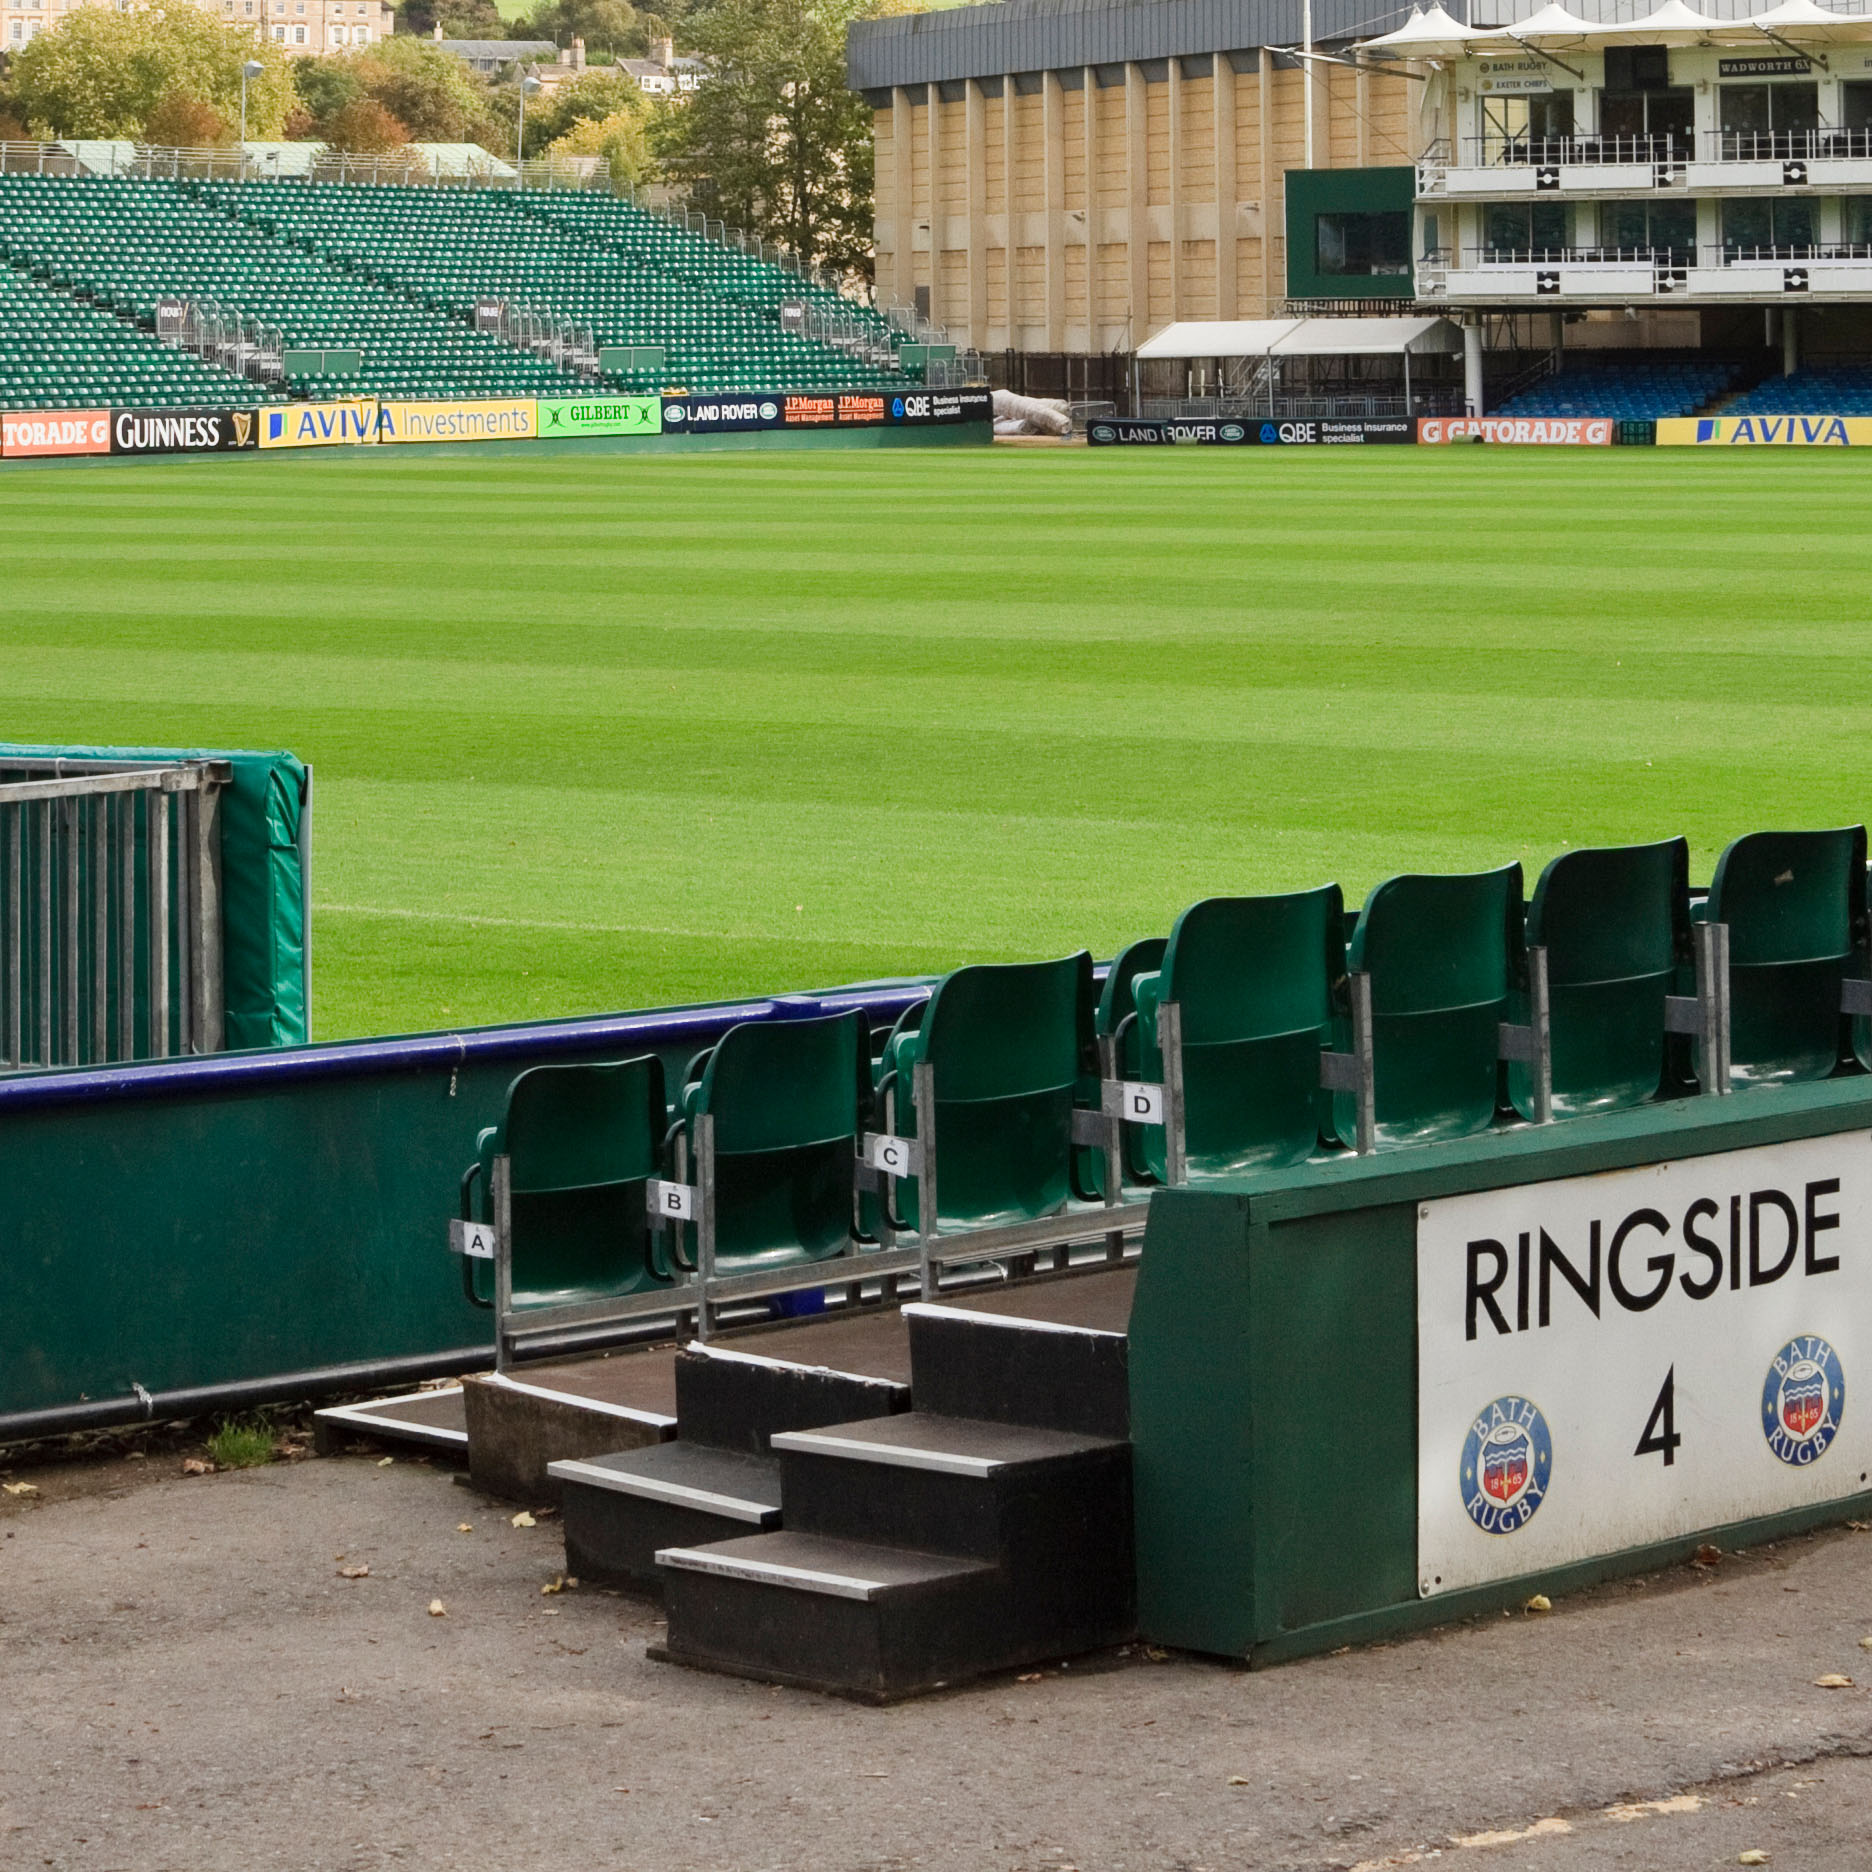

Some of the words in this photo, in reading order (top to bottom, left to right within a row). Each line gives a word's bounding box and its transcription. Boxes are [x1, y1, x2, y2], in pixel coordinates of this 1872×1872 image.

[1721, 60, 1791, 76] WADWORTH
[785, 397, 834, 412] J.P.Morgan
[837, 396, 884, 411] J.P.Morgan
[905, 396, 930, 416] QBE
[933, 396, 958, 405] Business
[570, 405, 630, 422] GILBERT
[687, 406, 721, 421] LAND
[722, 404, 758, 420] ROVER
[933, 406, 961, 417] specialist
[116, 412, 219, 449] GUINNESS
[298, 408, 396, 439] AVIVA
[403, 407, 529, 436] Investments
[1322, 422, 1362, 432] Business
[1364, 422, 1408, 433] insurance
[1447, 421, 1582, 443] GATORADE
[1731, 418, 1850, 445] AVIVA
[1118, 427, 1157, 442] LAND
[1279, 423, 1316, 443] QBE
[1322, 433, 1365, 443] specialist
[1134, 1095, 1152, 1114] D
[883, 1147, 898, 1165] C
[668, 1193, 681, 1210] B
[471, 1235, 485, 1251] A
[1466, 1178, 1840, 1340] RINGSIDE
[1773, 1337, 1832, 1378] BATH
[1473, 1397, 1537, 1437] BATH
[1634, 1363, 1681, 1467] 4
[1769, 1413, 1838, 1464] RUGBY
[1467, 1478, 1546, 1532] RUGBY
